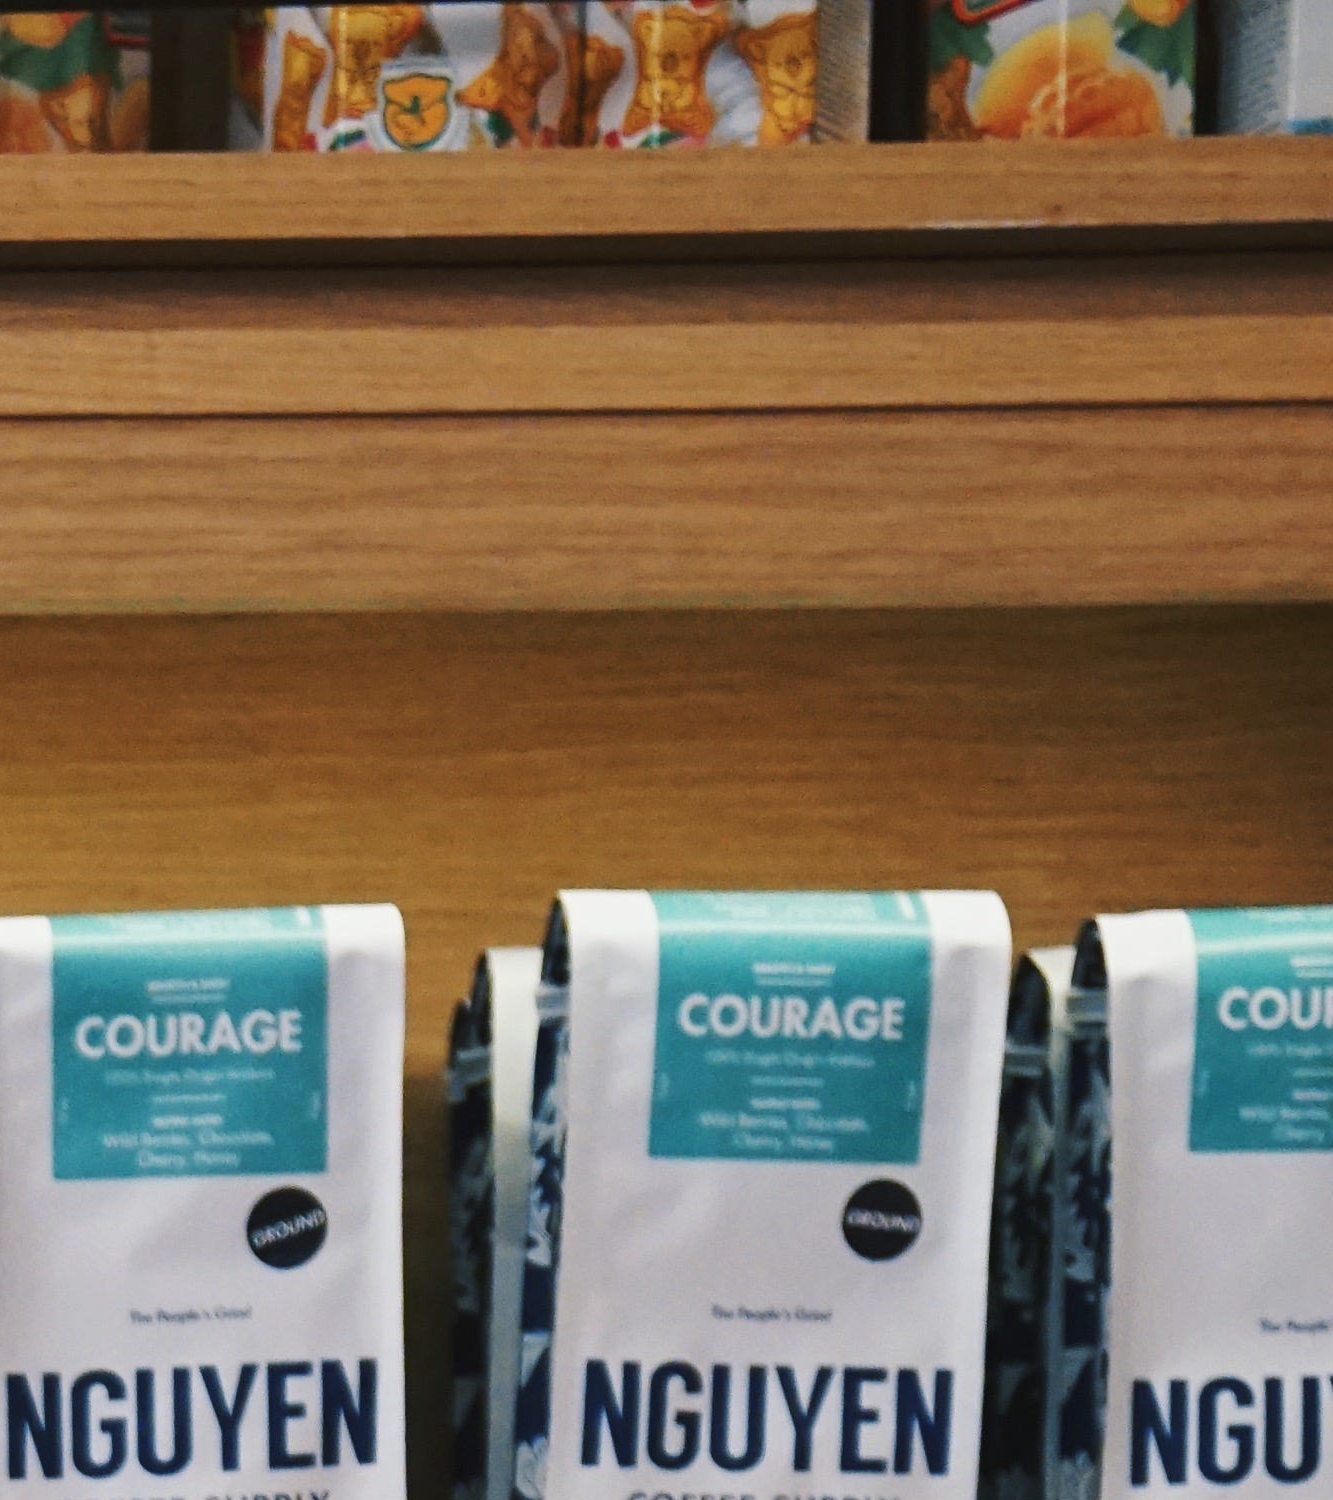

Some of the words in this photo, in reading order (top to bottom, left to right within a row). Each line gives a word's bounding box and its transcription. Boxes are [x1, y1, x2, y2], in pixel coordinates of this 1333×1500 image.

[74, 1009, 304, 1060] COURAGE
[677, 993, 905, 1041] COURAGE
[251, 1207, 326, 1247] GROUND
[5, 1358, 379, 1480] NGUYEN
[580, 1357, 956, 1475] NGUYEN
[1130, 1376, 1333, 1487] NGU
